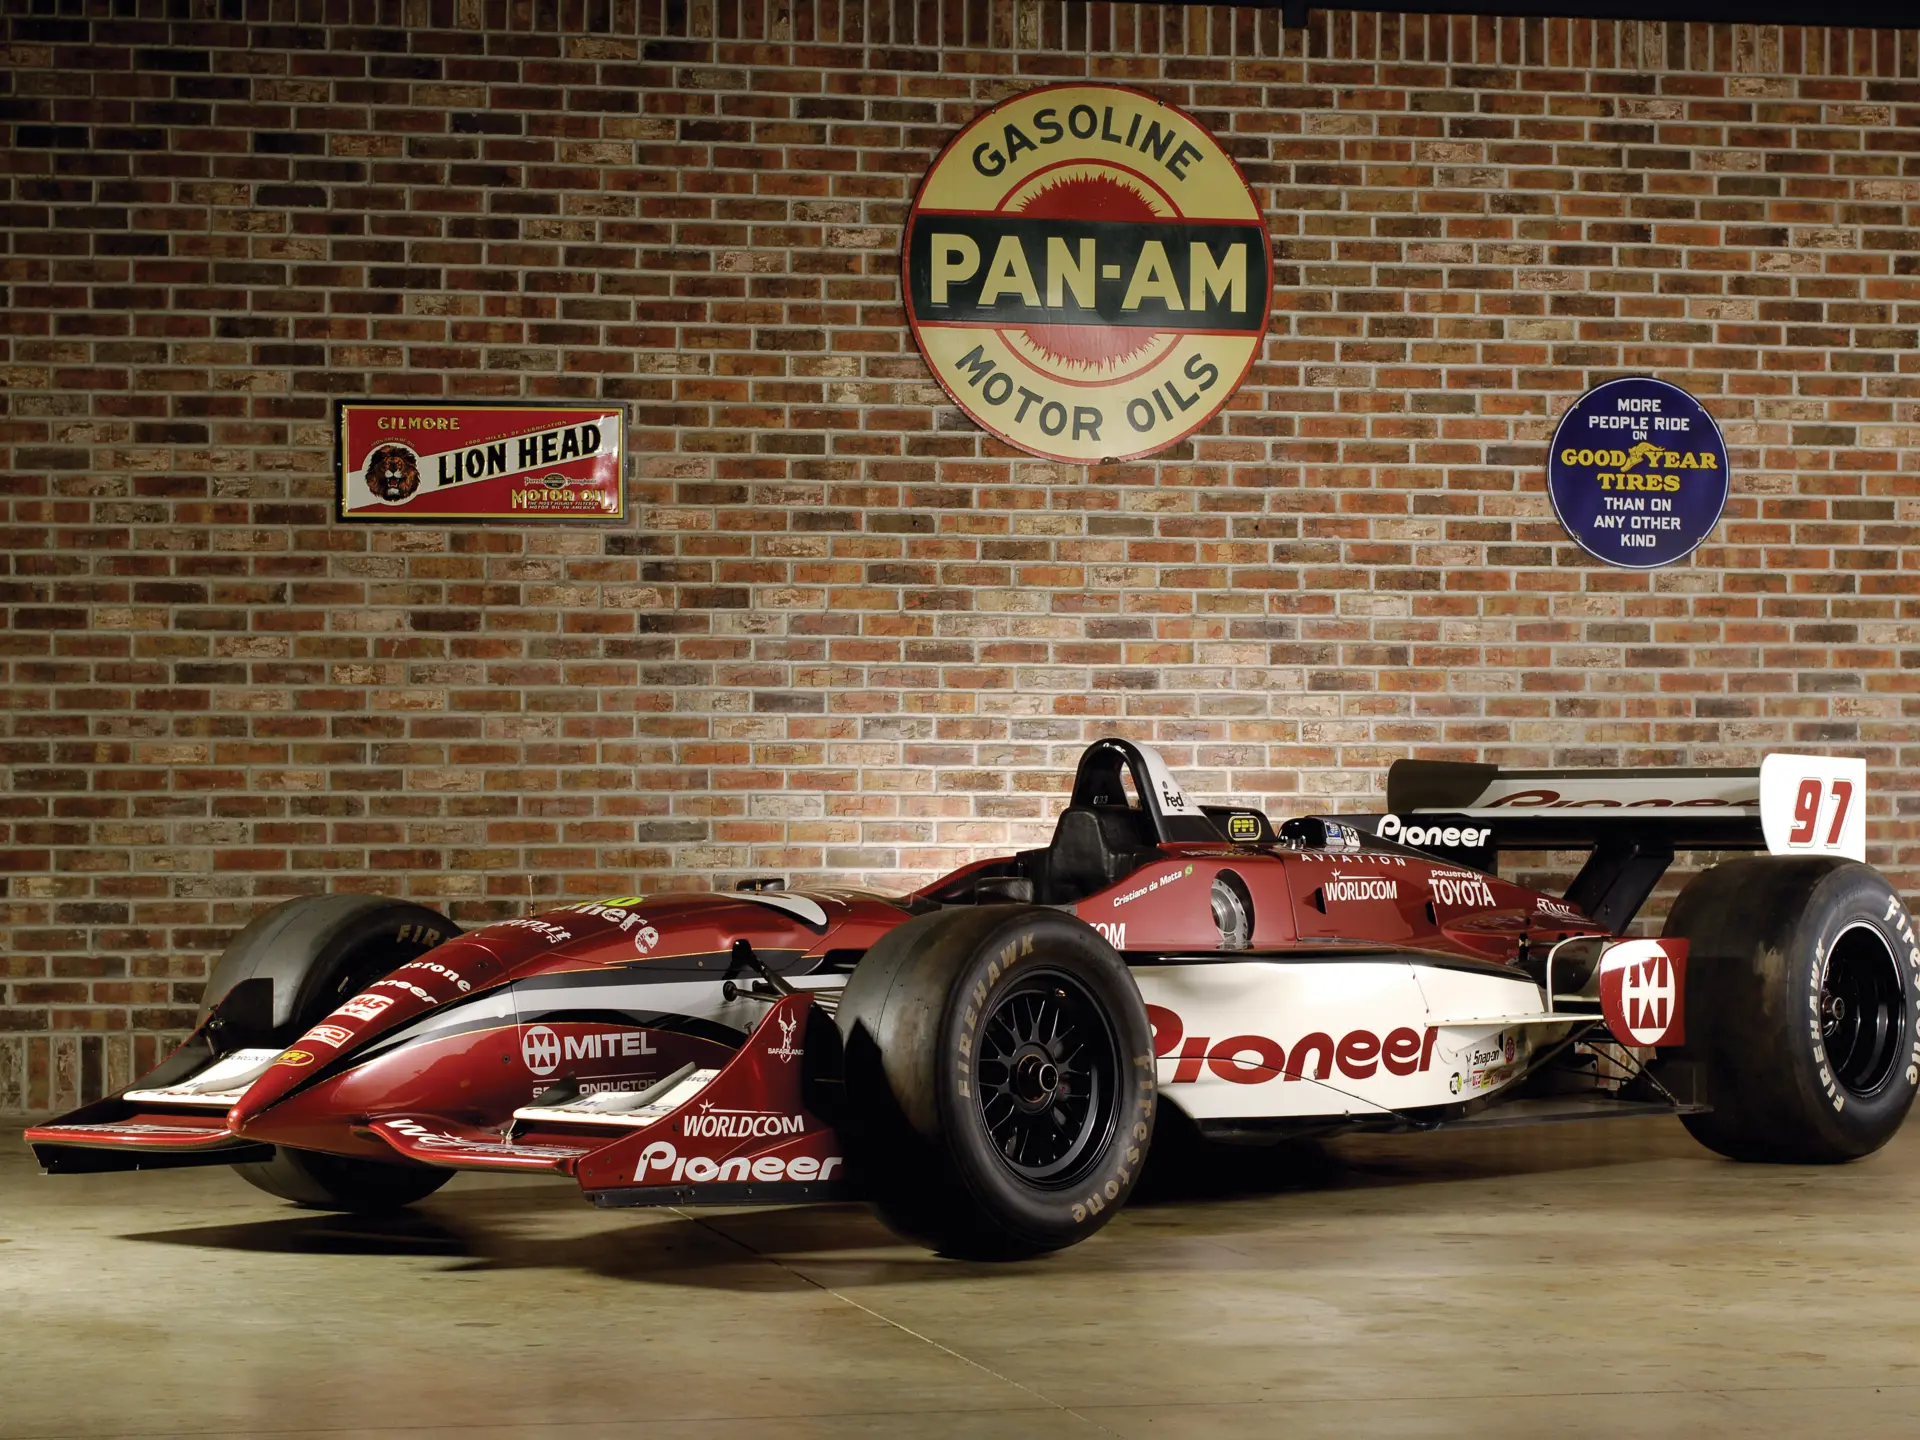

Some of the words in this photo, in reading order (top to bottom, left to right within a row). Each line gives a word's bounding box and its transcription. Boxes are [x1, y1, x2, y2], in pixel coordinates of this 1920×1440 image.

[972, 104, 1204, 182] GASOLINE
[930, 233, 1247, 313] PAN-AM
[954, 344, 1104, 442] MOTOR
[1126, 353, 1219, 433] OILS
[1617, 398, 1662, 413] MORE
[377, 416, 461, 431] GILMORE
[1588, 416, 1649, 430] PEOPLE
[1654, 417, 1690, 431] RIDE
[1632, 430, 1648, 441] ON
[437, 442, 507, 487] LION
[517, 423, 602, 470] HEAD
[1596, 473, 1680, 492] TIRES
[511, 488, 575, 509] MOTOR
[580, 488, 614, 510] OIL
[1604, 497, 1645, 511] THAN
[1651, 499, 1672, 512] ON
[1593, 515, 1626, 529] ANY
[1630, 517, 1681, 530] OTHER
[1620, 534, 1656, 548] KIND
[1788, 778, 1855, 846] 97
[1376, 813, 1492, 848] Pioneer
[1301, 853, 1406, 867] AVIATION
[1430, 869, 1474, 879] powered
[1473, 871, 1484, 882] by
[1113, 886, 1148, 908] Cristiano
[1149, 881, 1159, 892] da
[1159, 870, 1183, 887] Matta
[1324, 880, 1398, 901] WORLDCOM
[1428, 878, 1497, 907] TOYOTA
[396, 924, 450, 947] FIR
[956, 932, 1036, 1100] FIREHAWK
[1809, 937, 1846, 1113] FIREHAWK
[564, 1031, 657, 1062] MITEL
[1472, 1049, 1500, 1067] Snap-on
[683, 1115, 805, 1138] WORLDCOM
[1070, 1049, 1156, 1224] Firestone
[633, 1141, 843, 1182] Pioneer
